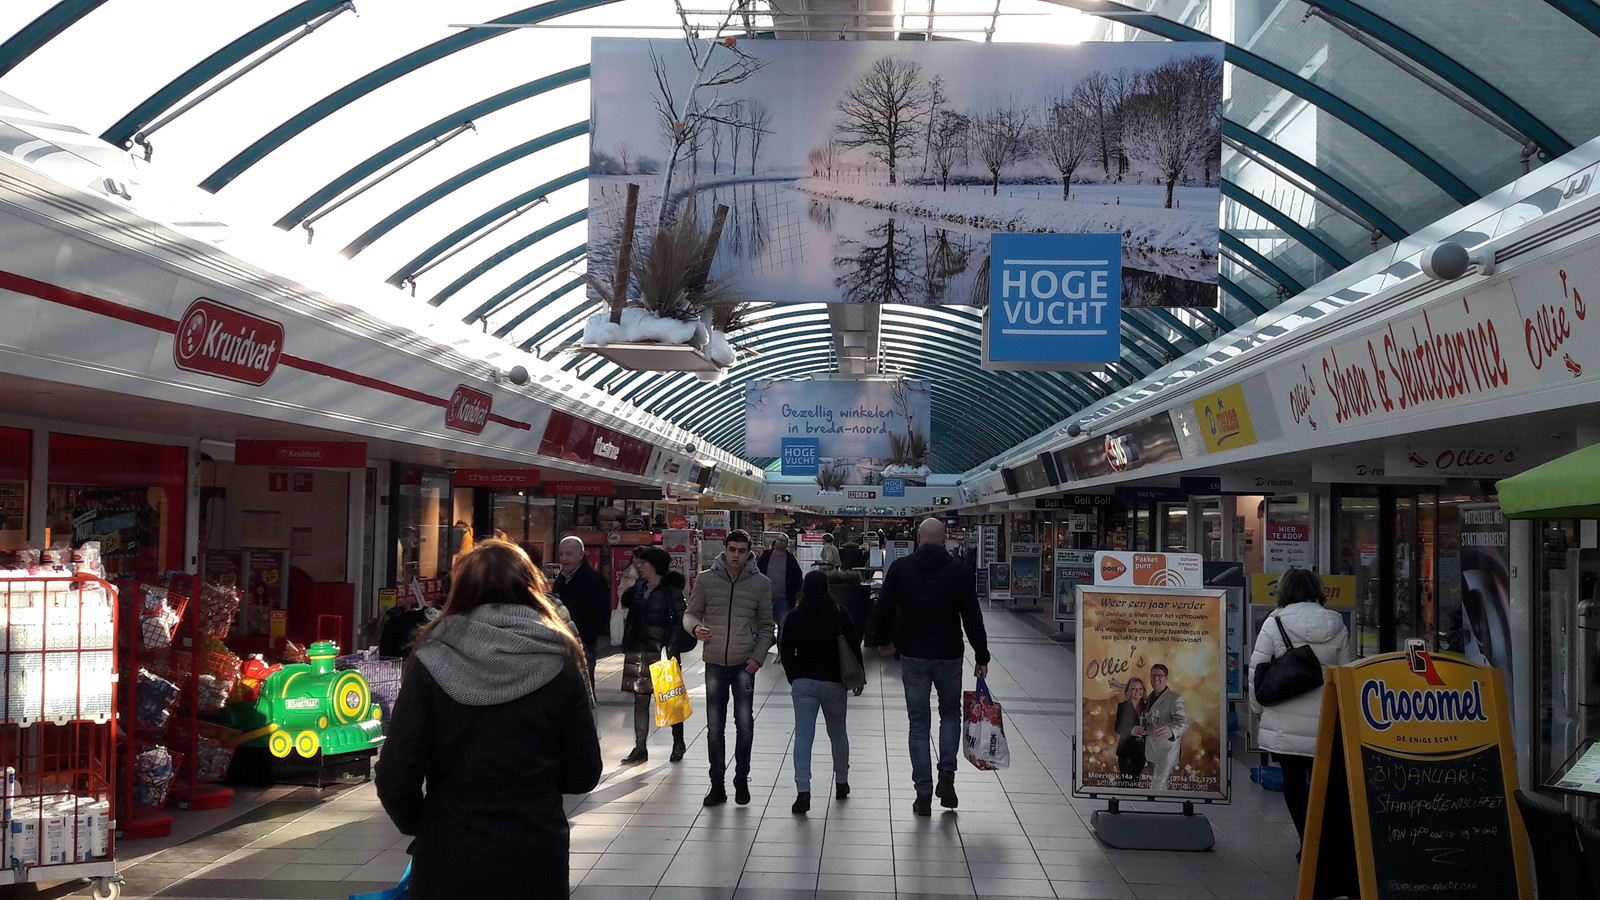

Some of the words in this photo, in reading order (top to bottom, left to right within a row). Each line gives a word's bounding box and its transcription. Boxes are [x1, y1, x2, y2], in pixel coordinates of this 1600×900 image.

[1002, 269, 1108, 299] HOGE
[1003, 301, 1108, 325] VUCHT
[1525, 269, 1586, 370] Ollie's
[202, 318, 278, 373] Kruidvat
[1322, 346, 1377, 424] Schoen
[1368, 339, 1394, 412] &
[1384, 296, 1509, 410] Sleutelservice
[456, 396, 490, 427] Kruidvat
[781, 403, 833, 422] Gezellig
[840, 404, 894, 418] winkelen
[788, 422, 799, 434] in
[289, 449, 321, 458] Kruidvat
[784, 447, 816, 457] HOGE
[1436, 448, 1517, 470] Ollie's
[785, 457, 815, 465] VUCHT
[468, 473, 489, 482] the
[1074, 495, 1091, 505] Gall
[1094, 496, 1111, 505] Gall
[1135, 555, 1159, 563] Pakket
[1101, 598, 1127, 608] Weer
[1128, 600, 1147, 609] een
[1148, 600, 1170, 610] jaar
[1172, 600, 1206, 610] verder
[1095, 610, 1104, 618] Wij
[1105, 610, 1128, 618] danken
[1113, 634, 1138, 642] gelukkig
[1086, 645, 1146, 680] Ollie's
[1361, 679, 1489, 731] Chocomel
[1434, 736, 1458, 744] ECHTE
[1374, 765, 1391, 782] 31
